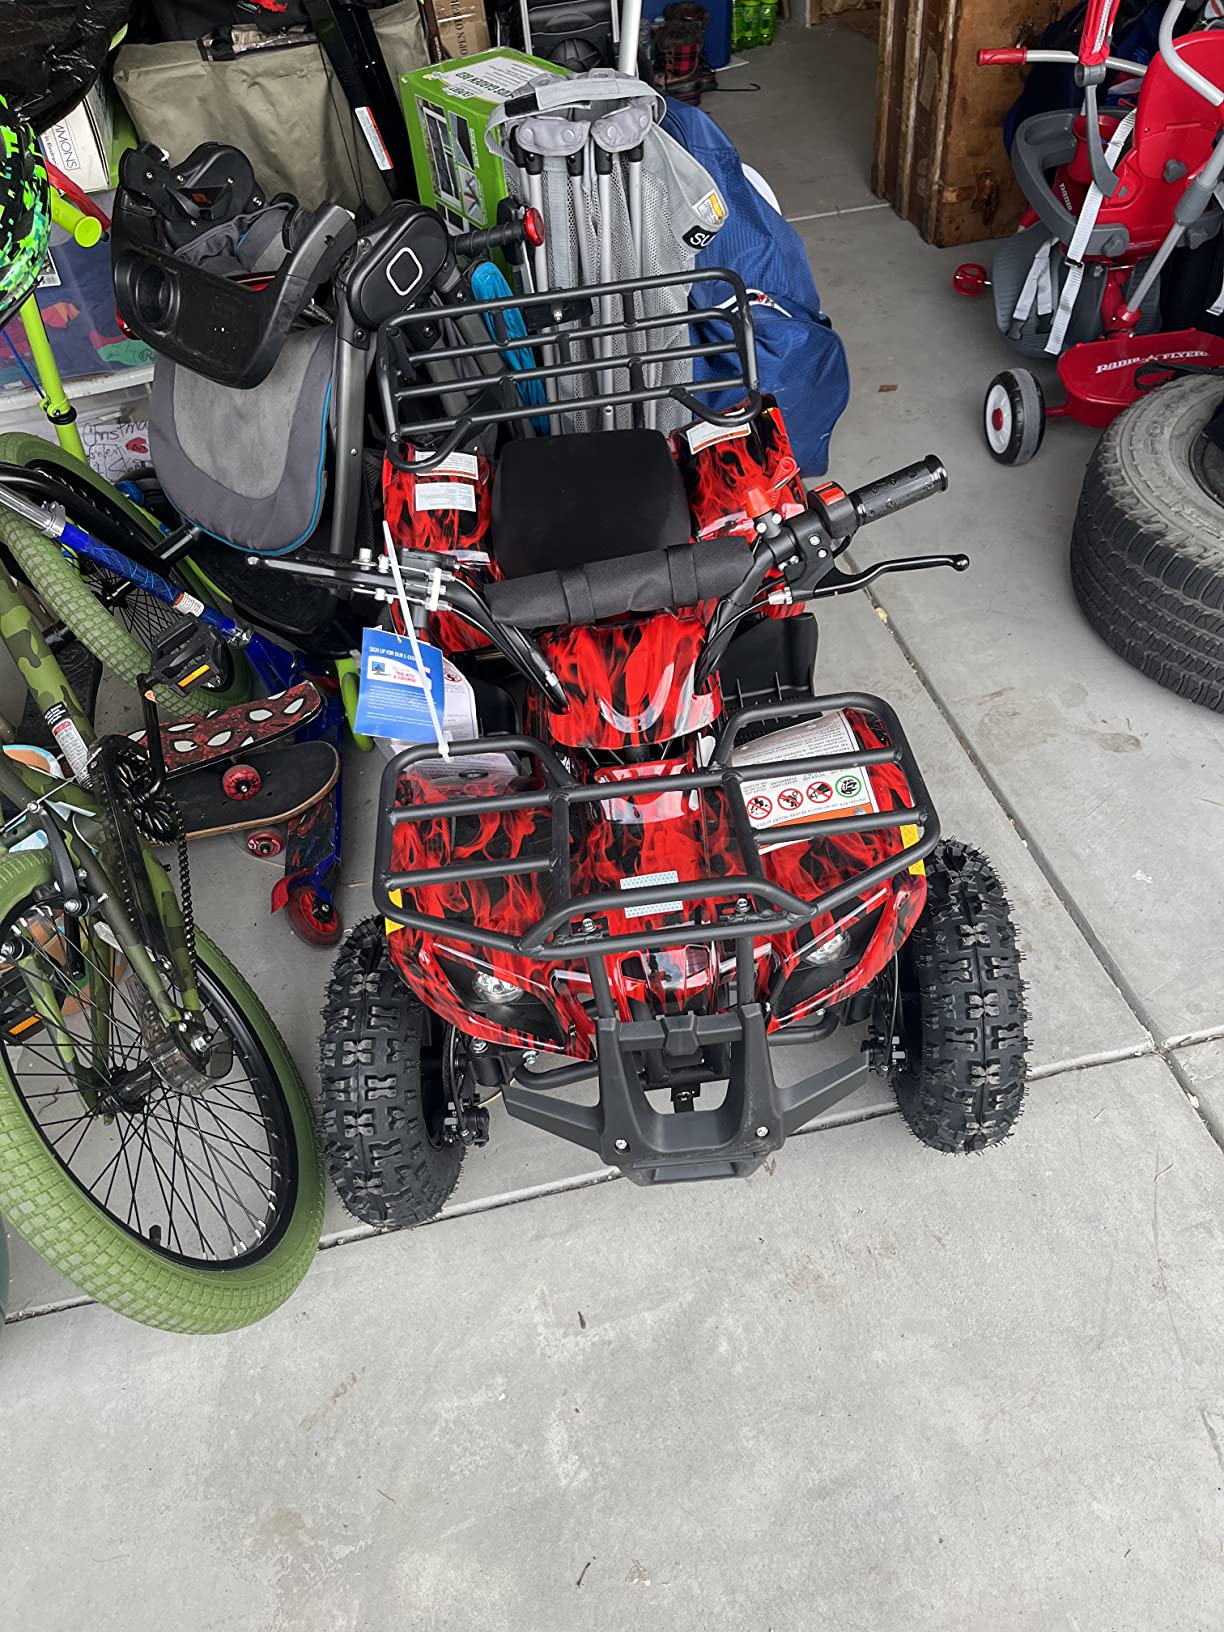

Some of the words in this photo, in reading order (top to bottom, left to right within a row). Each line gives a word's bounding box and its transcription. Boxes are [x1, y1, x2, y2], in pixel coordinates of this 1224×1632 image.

[457, 31, 468, 55] OPEN
[1095, 357, 1140, 373] RADIO
[1162, 350, 1209, 360] FLYER
